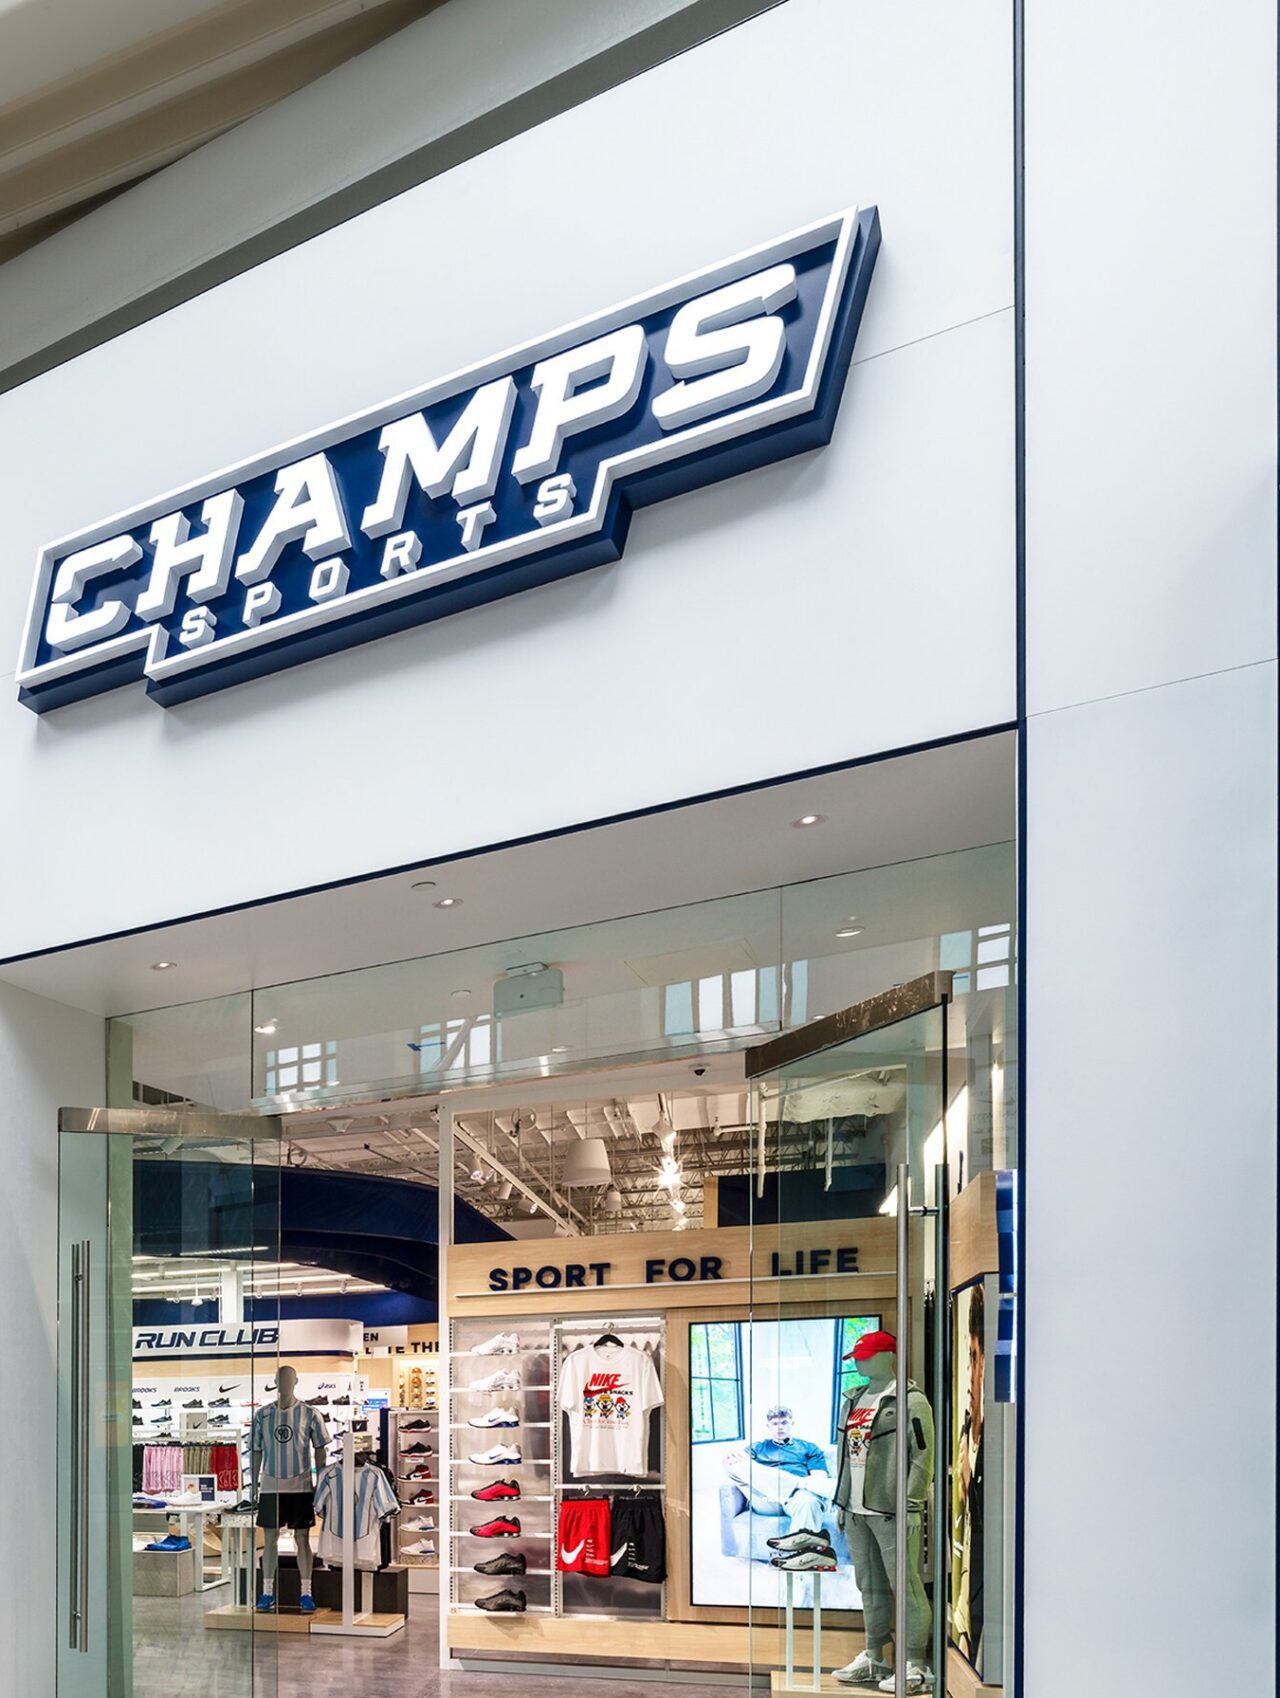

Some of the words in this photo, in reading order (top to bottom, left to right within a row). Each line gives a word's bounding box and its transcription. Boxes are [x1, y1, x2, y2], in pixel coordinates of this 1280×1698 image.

[46, 263, 797, 652] CHAMPS
[180, 472, 576, 648] SPORTS
[488, 1262, 611, 1292] SPORT
[645, 1256, 724, 1284] FOR
[771, 1247, 860, 1277] LIFE
[134, 1331, 197, 1349] RUN
[198, 1327, 280, 1347] CLUB
[363, 1332, 379, 1342] EN
[589, 1373, 622, 1387] NIKE
